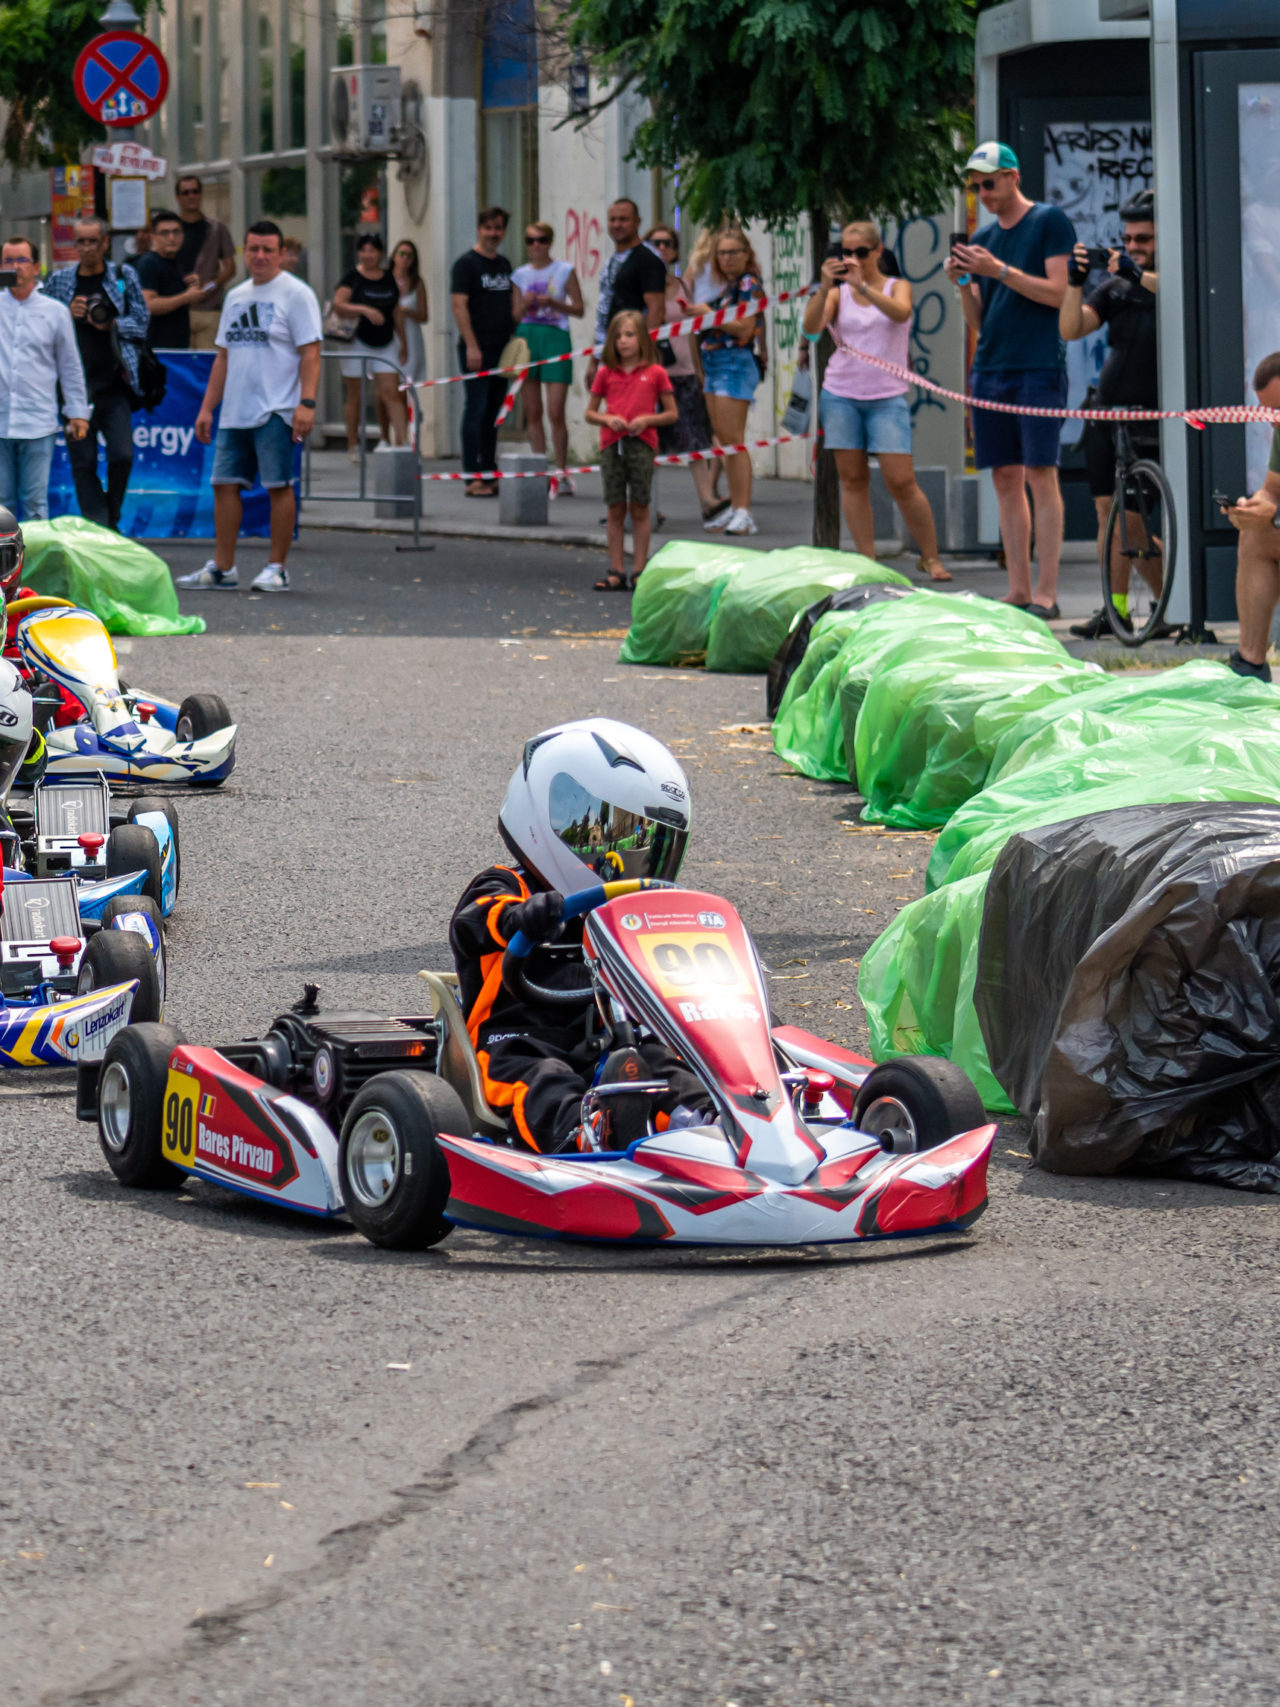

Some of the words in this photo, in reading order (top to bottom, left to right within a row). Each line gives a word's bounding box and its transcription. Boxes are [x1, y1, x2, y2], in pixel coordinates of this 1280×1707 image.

[225, 330, 269, 343] adidas
[133, 424, 195, 456] ergy
[652, 942, 738, 987] 90
[84, 1001, 126, 1038] Lenzokart
[165, 1091, 194, 1156] 90
